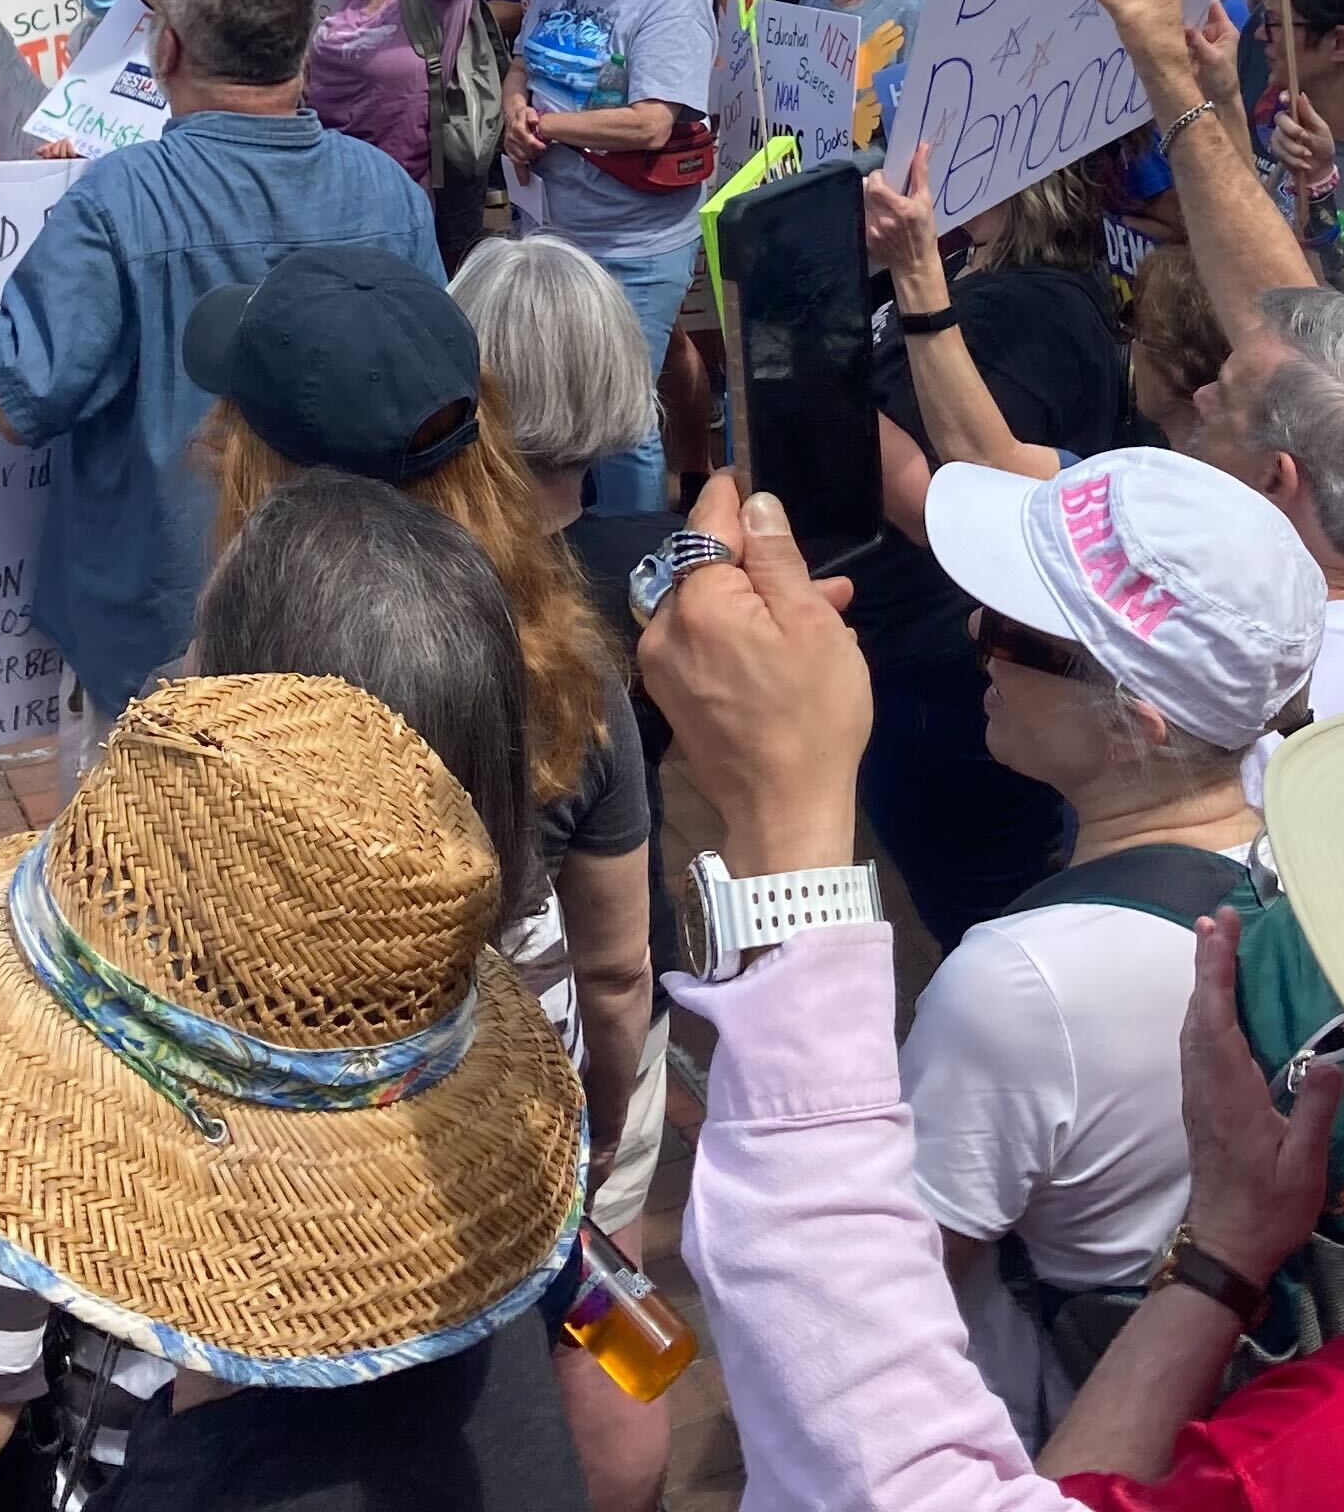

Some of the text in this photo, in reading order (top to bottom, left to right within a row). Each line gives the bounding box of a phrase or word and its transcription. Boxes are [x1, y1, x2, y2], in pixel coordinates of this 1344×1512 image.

[765, 16, 857, 83] Education NIH
[774, 81, 801, 113] NOAA
[796, 56, 836, 105] Science
[815, 127, 850, 161] Books
